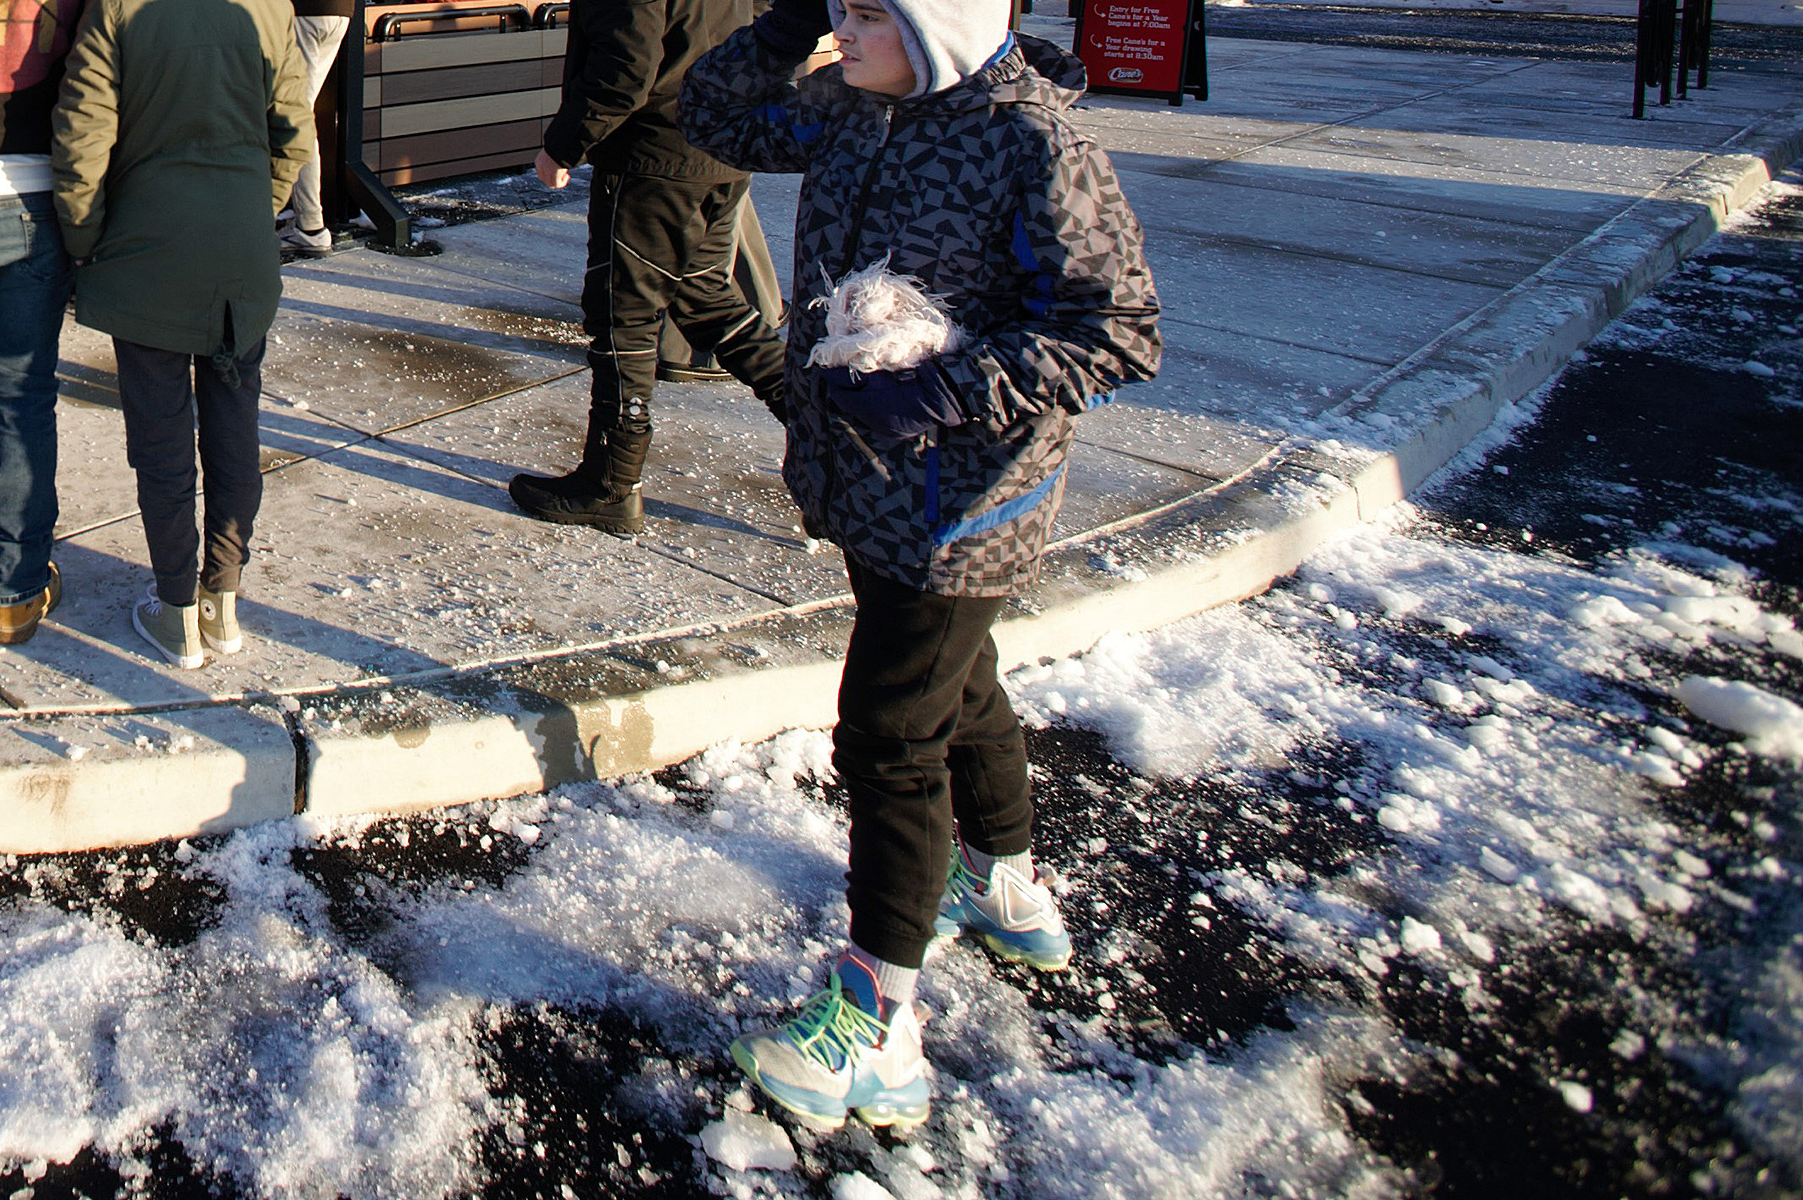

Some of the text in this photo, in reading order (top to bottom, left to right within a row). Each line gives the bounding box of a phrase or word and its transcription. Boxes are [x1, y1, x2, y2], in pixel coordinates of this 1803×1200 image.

[1109, 5, 1129, 14] Entry
[1143, 6, 1159, 14] Free
[1152, 14, 1168, 22] Year
[1107, 19, 1131, 28] begins
[1142, 20, 1171, 29] 7:00am
[1105, 36, 1122, 44] Free
[1147, 38, 1159, 46] for
[1122, 44, 1153, 55] drawing
